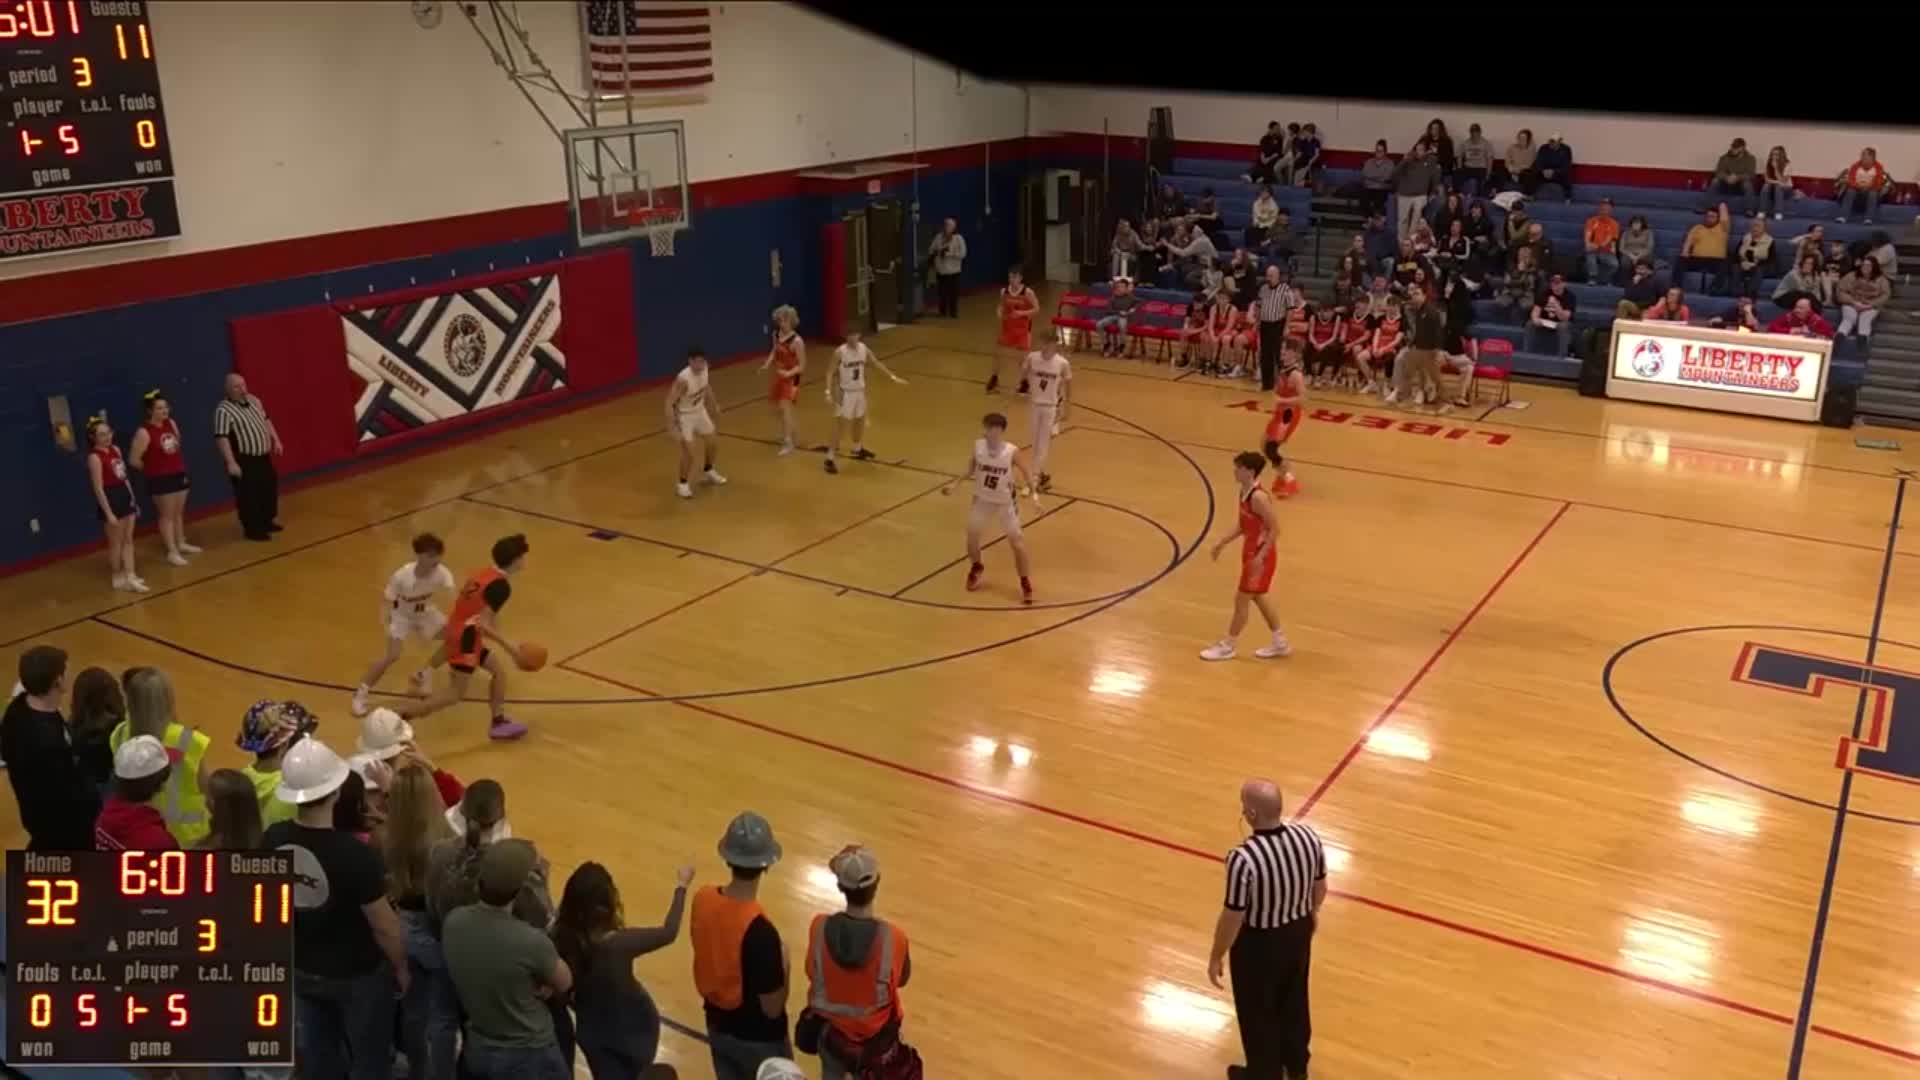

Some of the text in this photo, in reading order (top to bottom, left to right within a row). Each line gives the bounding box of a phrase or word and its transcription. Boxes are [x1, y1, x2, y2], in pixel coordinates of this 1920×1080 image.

[90, 1, 141, 17] Guests
[115, 24, 151, 59] 11
[9, 57, 93, 89] period 3
[13, 97, 64, 118] player
[120, 94, 156, 112] fouls
[58, 125, 80, 154] 5
[136, 120, 156, 148] 0
[32, 168, 71, 187] game
[135, 159, 163, 175] won
[0, 186, 148, 234] BERTY
[378, 354, 431, 397] LIBERTY
[1680, 344, 1804, 378] LIBERTY
[1678, 366, 1800, 393] MOUNTAINEERS
[1224, 399, 1512, 446] LIBERY
[983, 474, 1000, 490] 15
